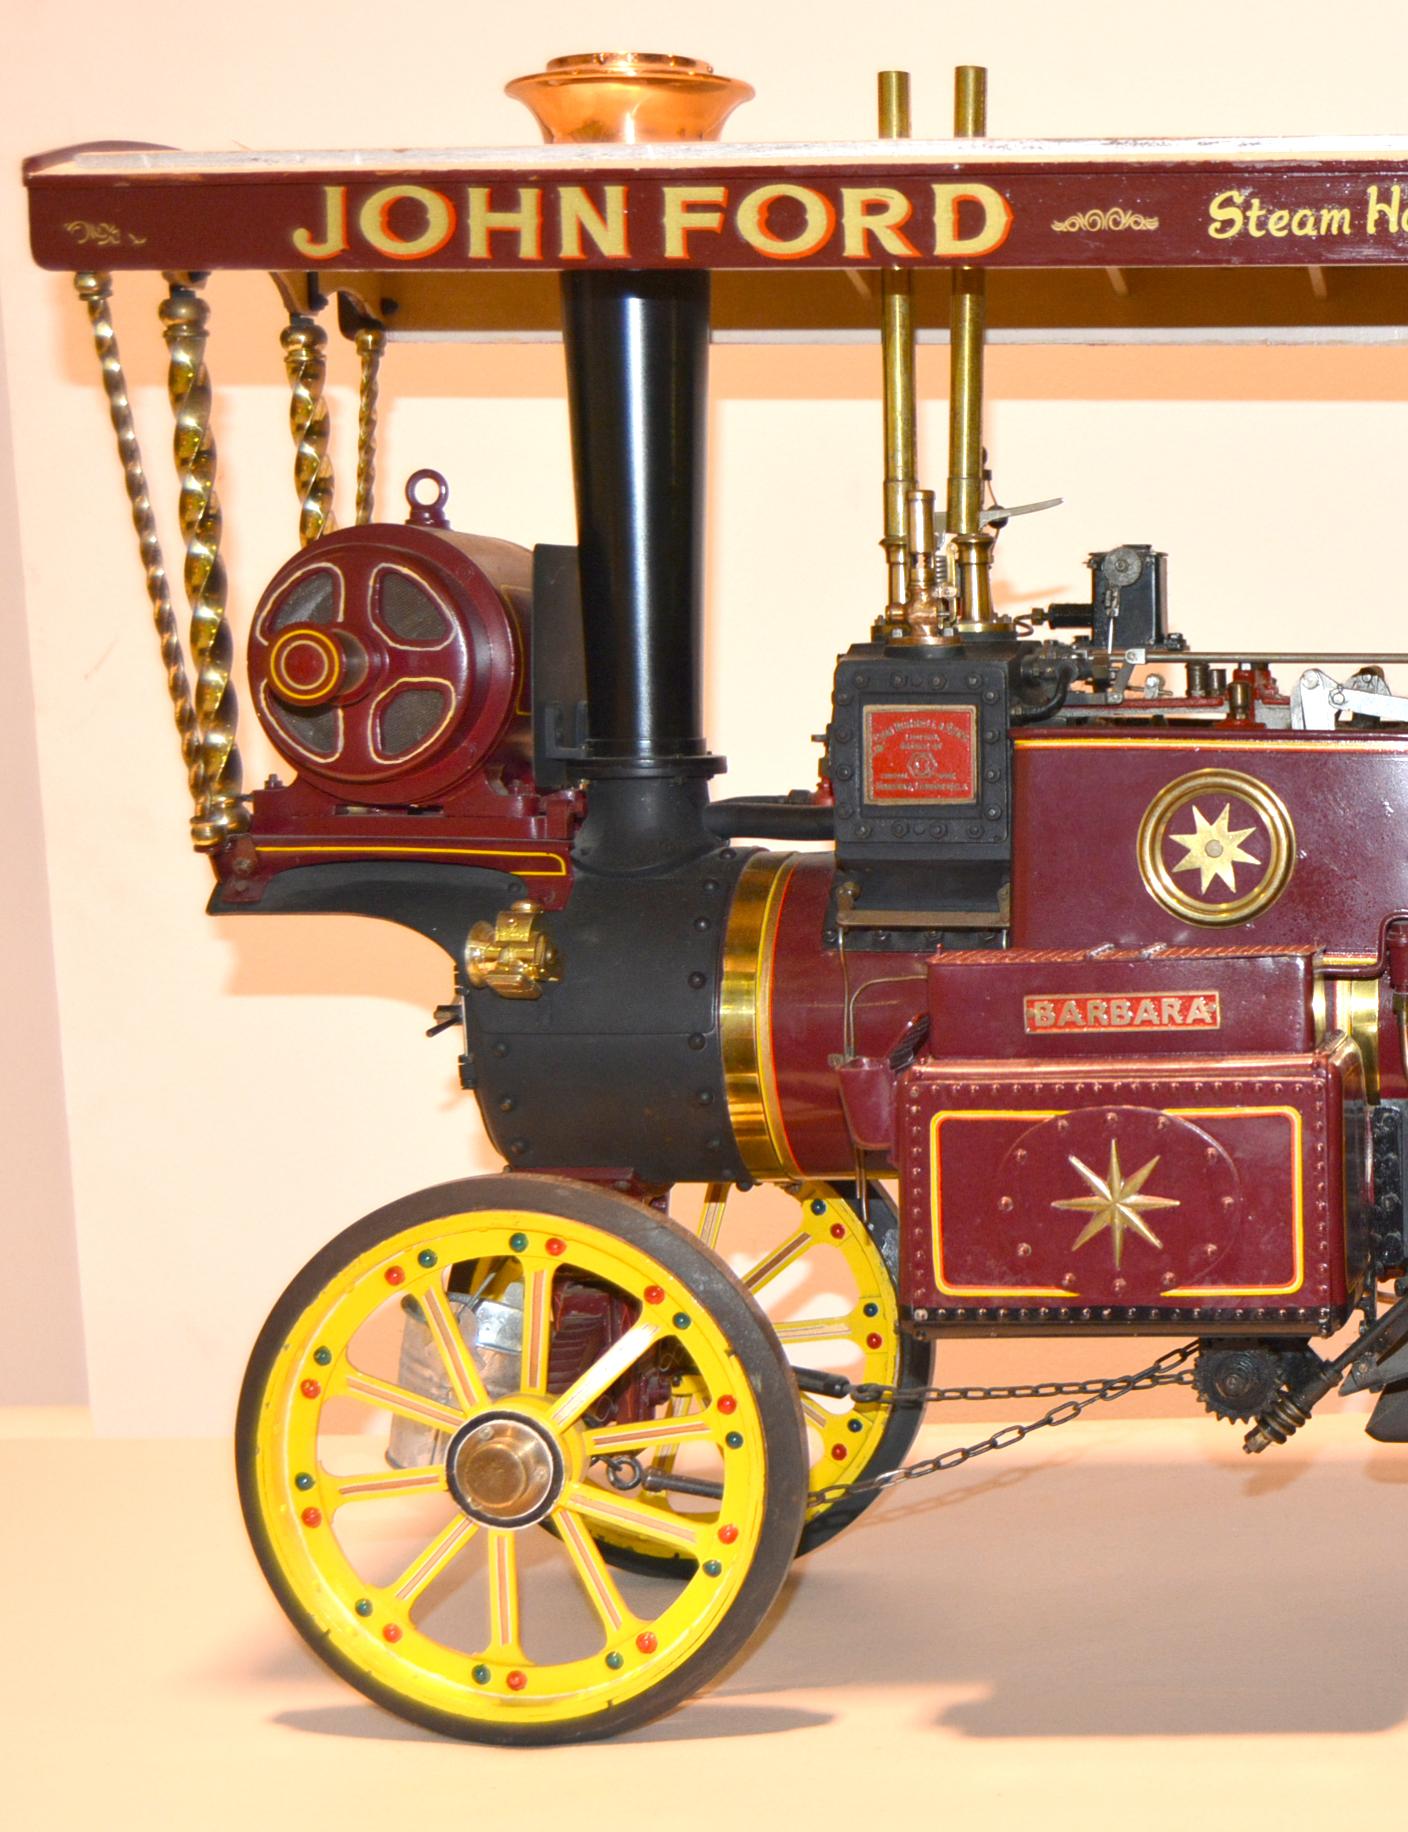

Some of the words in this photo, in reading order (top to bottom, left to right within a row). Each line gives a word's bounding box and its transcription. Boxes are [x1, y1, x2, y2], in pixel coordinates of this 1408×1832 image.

[293, 184, 631, 260] JOHN
[662, 182, 1014, 259] FORD
[1207, 190, 1351, 239] Steam
[1033, 998, 1213, 1027] BARBARA
